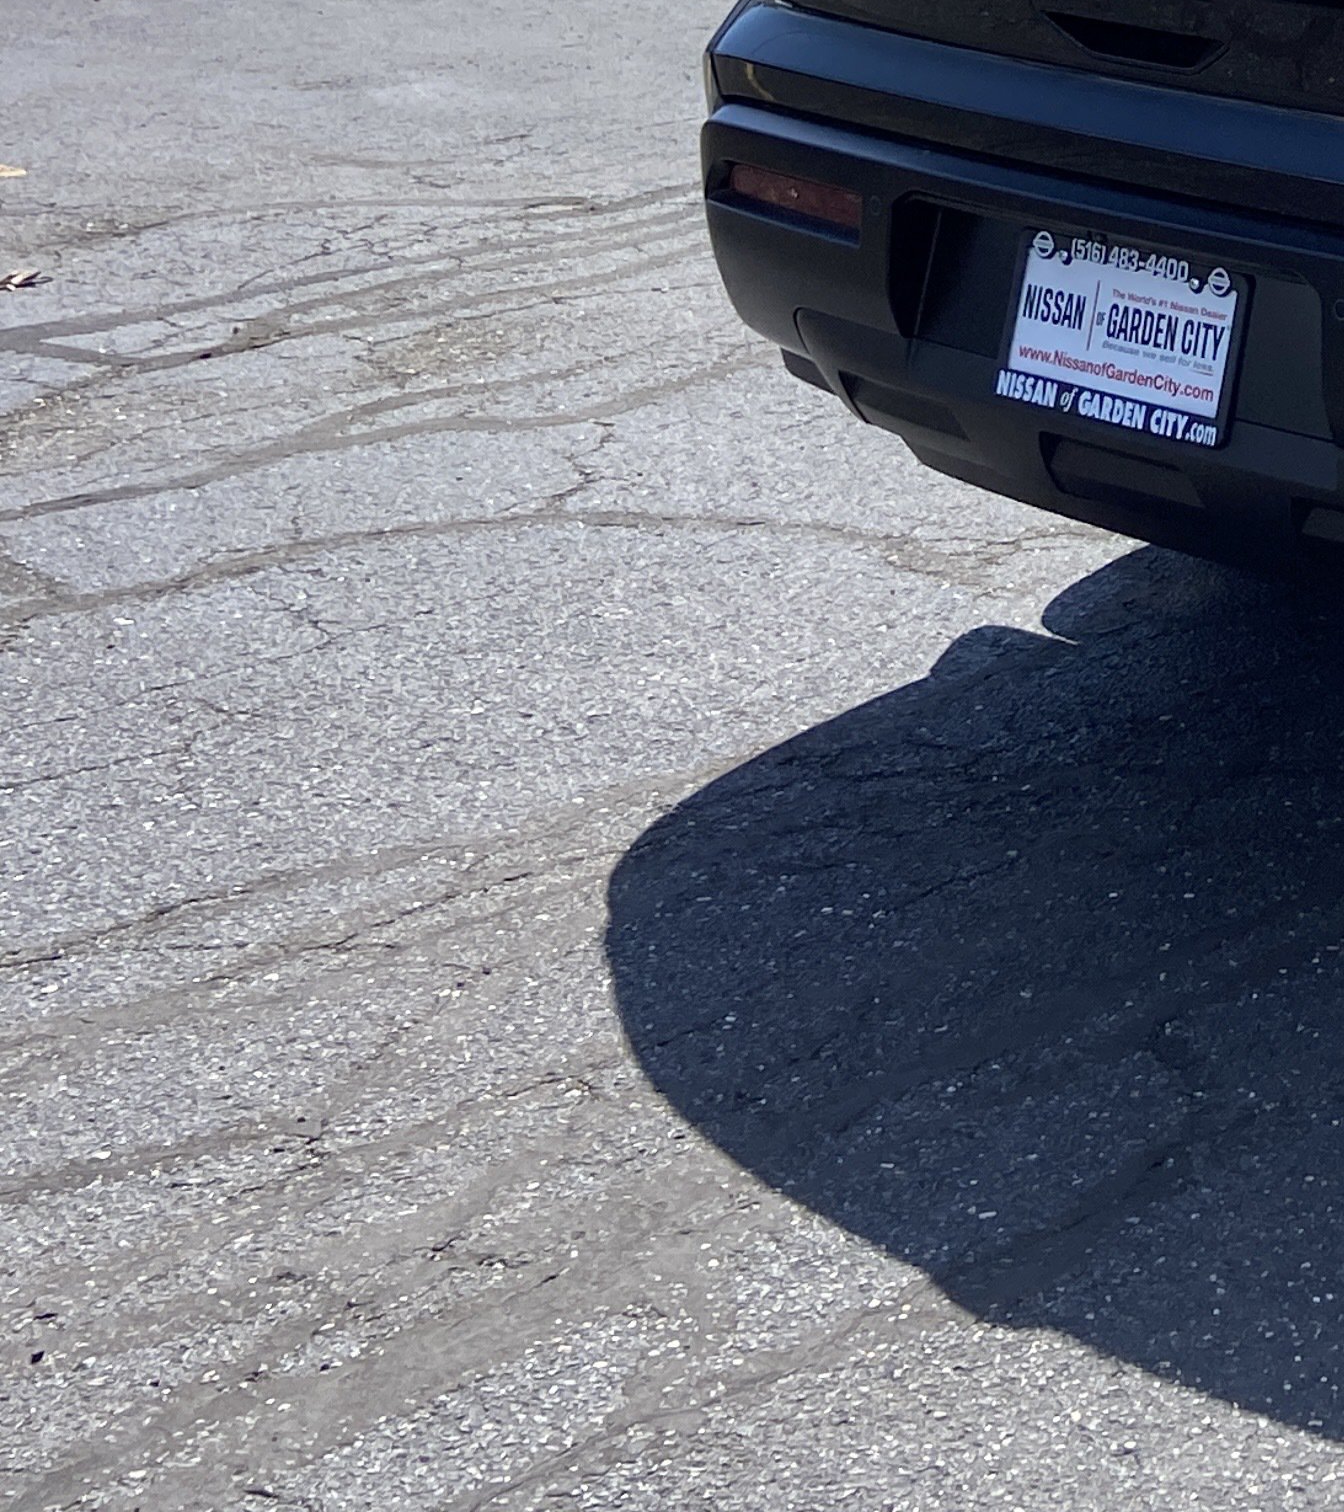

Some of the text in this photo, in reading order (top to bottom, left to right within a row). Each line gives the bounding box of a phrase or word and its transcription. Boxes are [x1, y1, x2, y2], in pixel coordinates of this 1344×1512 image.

[1071, 238, 1189, 282] (516) 483-4400
[1022, 284, 1086, 330] NISSAN
[1106, 303, 1179, 351] GARDEN
[1181, 319, 1226, 361] CITY
[1113, 288, 1126, 300] The
[1127, 290, 1156, 306] World's
[1170, 301, 1199, 315] Nissan
[1201, 307, 1228, 321] Dealer
[1018, 345, 1214, 401] www.NissanofGardenCity.com
[996, 369, 1217, 447] NISSAN of GARDEN CITY.com
